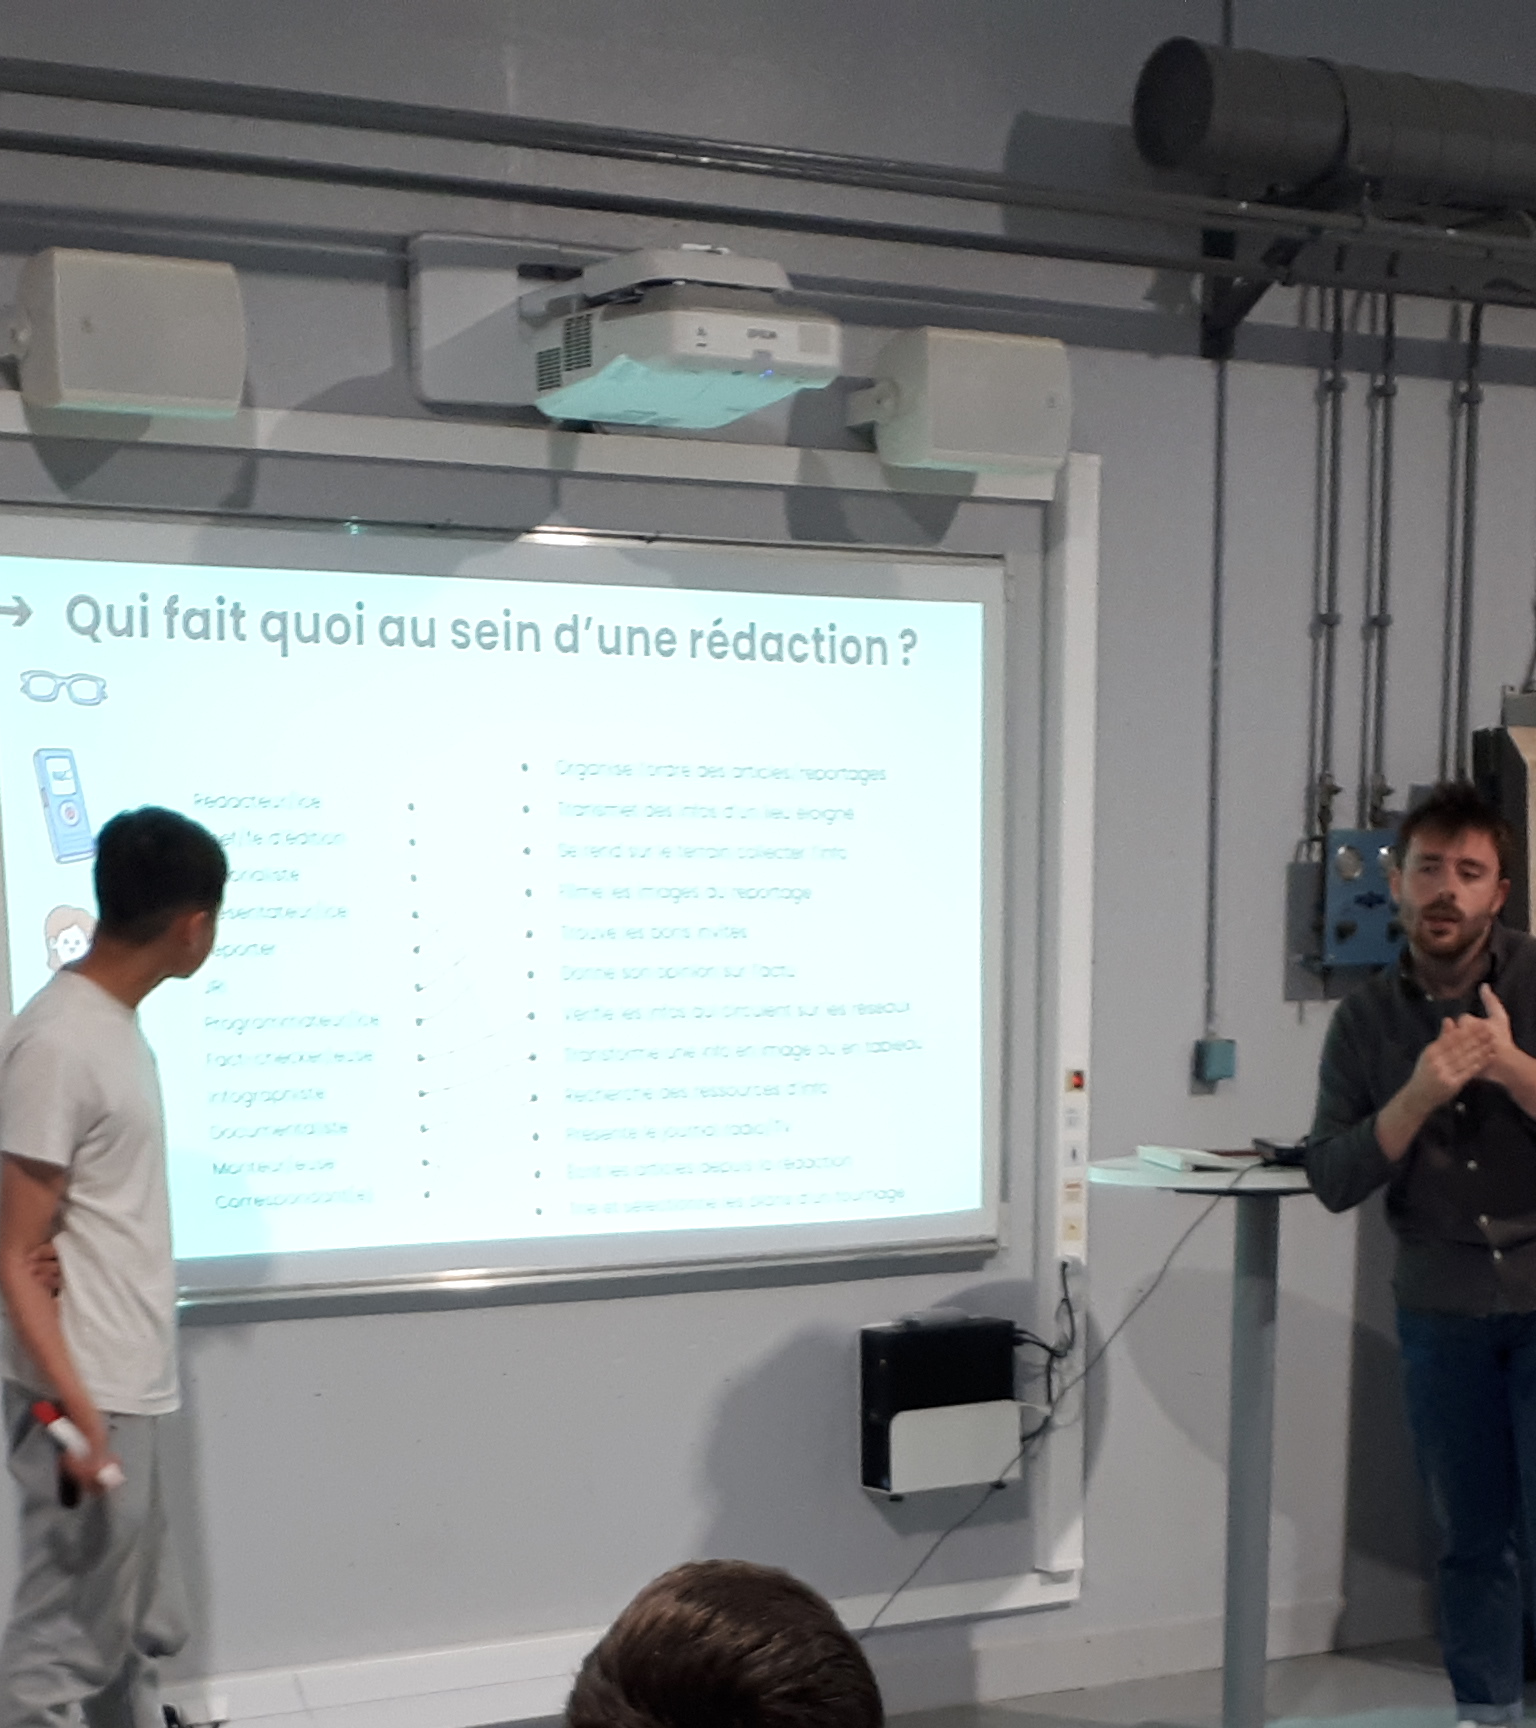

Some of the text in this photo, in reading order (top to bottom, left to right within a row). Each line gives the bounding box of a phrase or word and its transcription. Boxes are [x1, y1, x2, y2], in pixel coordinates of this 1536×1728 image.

[66, 591, 919, 666] Qui fait quoi au sein d'une rédaction ?
